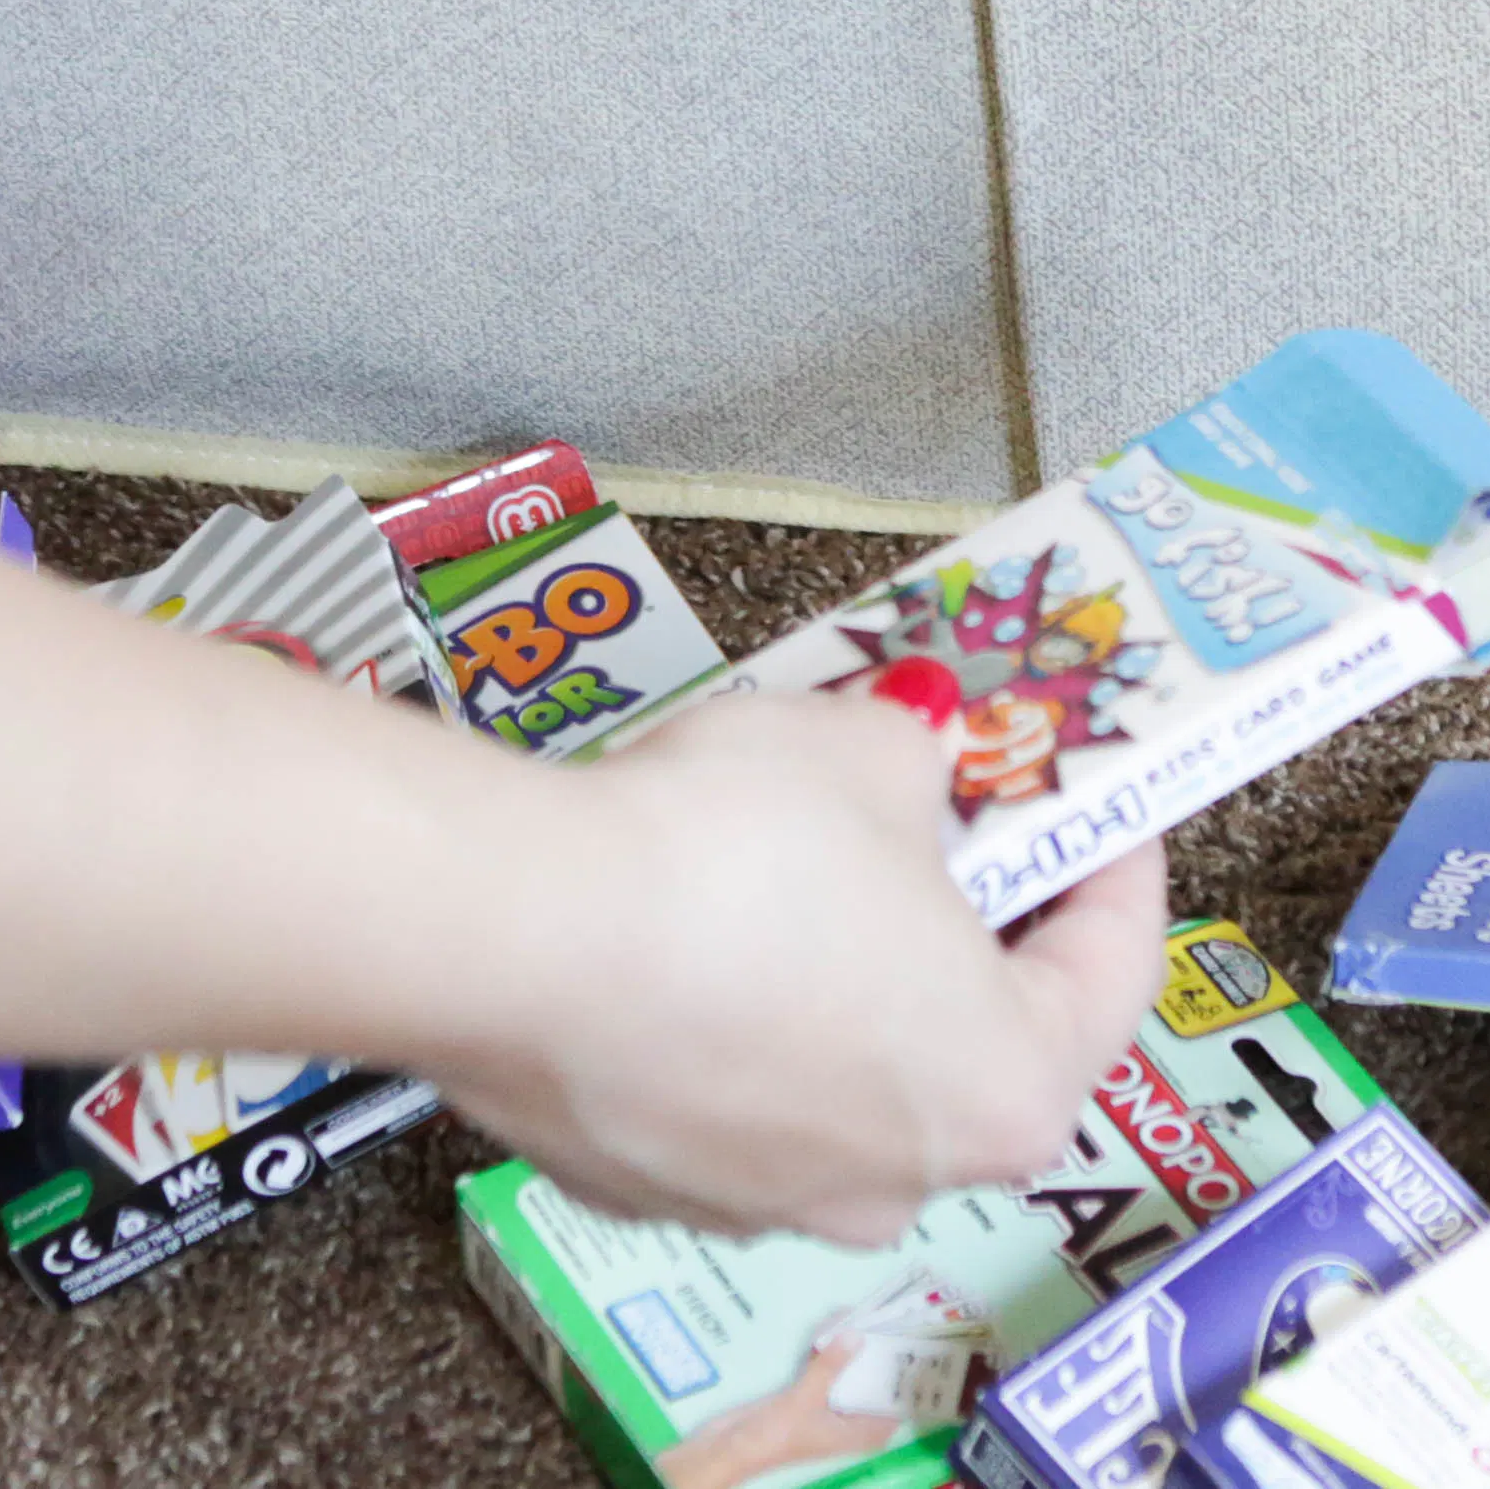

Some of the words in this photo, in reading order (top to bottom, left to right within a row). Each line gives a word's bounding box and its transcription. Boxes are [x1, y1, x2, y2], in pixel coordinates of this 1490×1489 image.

[1233, 686, 1309, 737] CARD
[1316, 633, 1393, 687] GAME
[41, 1226, 103, 1276] CE
